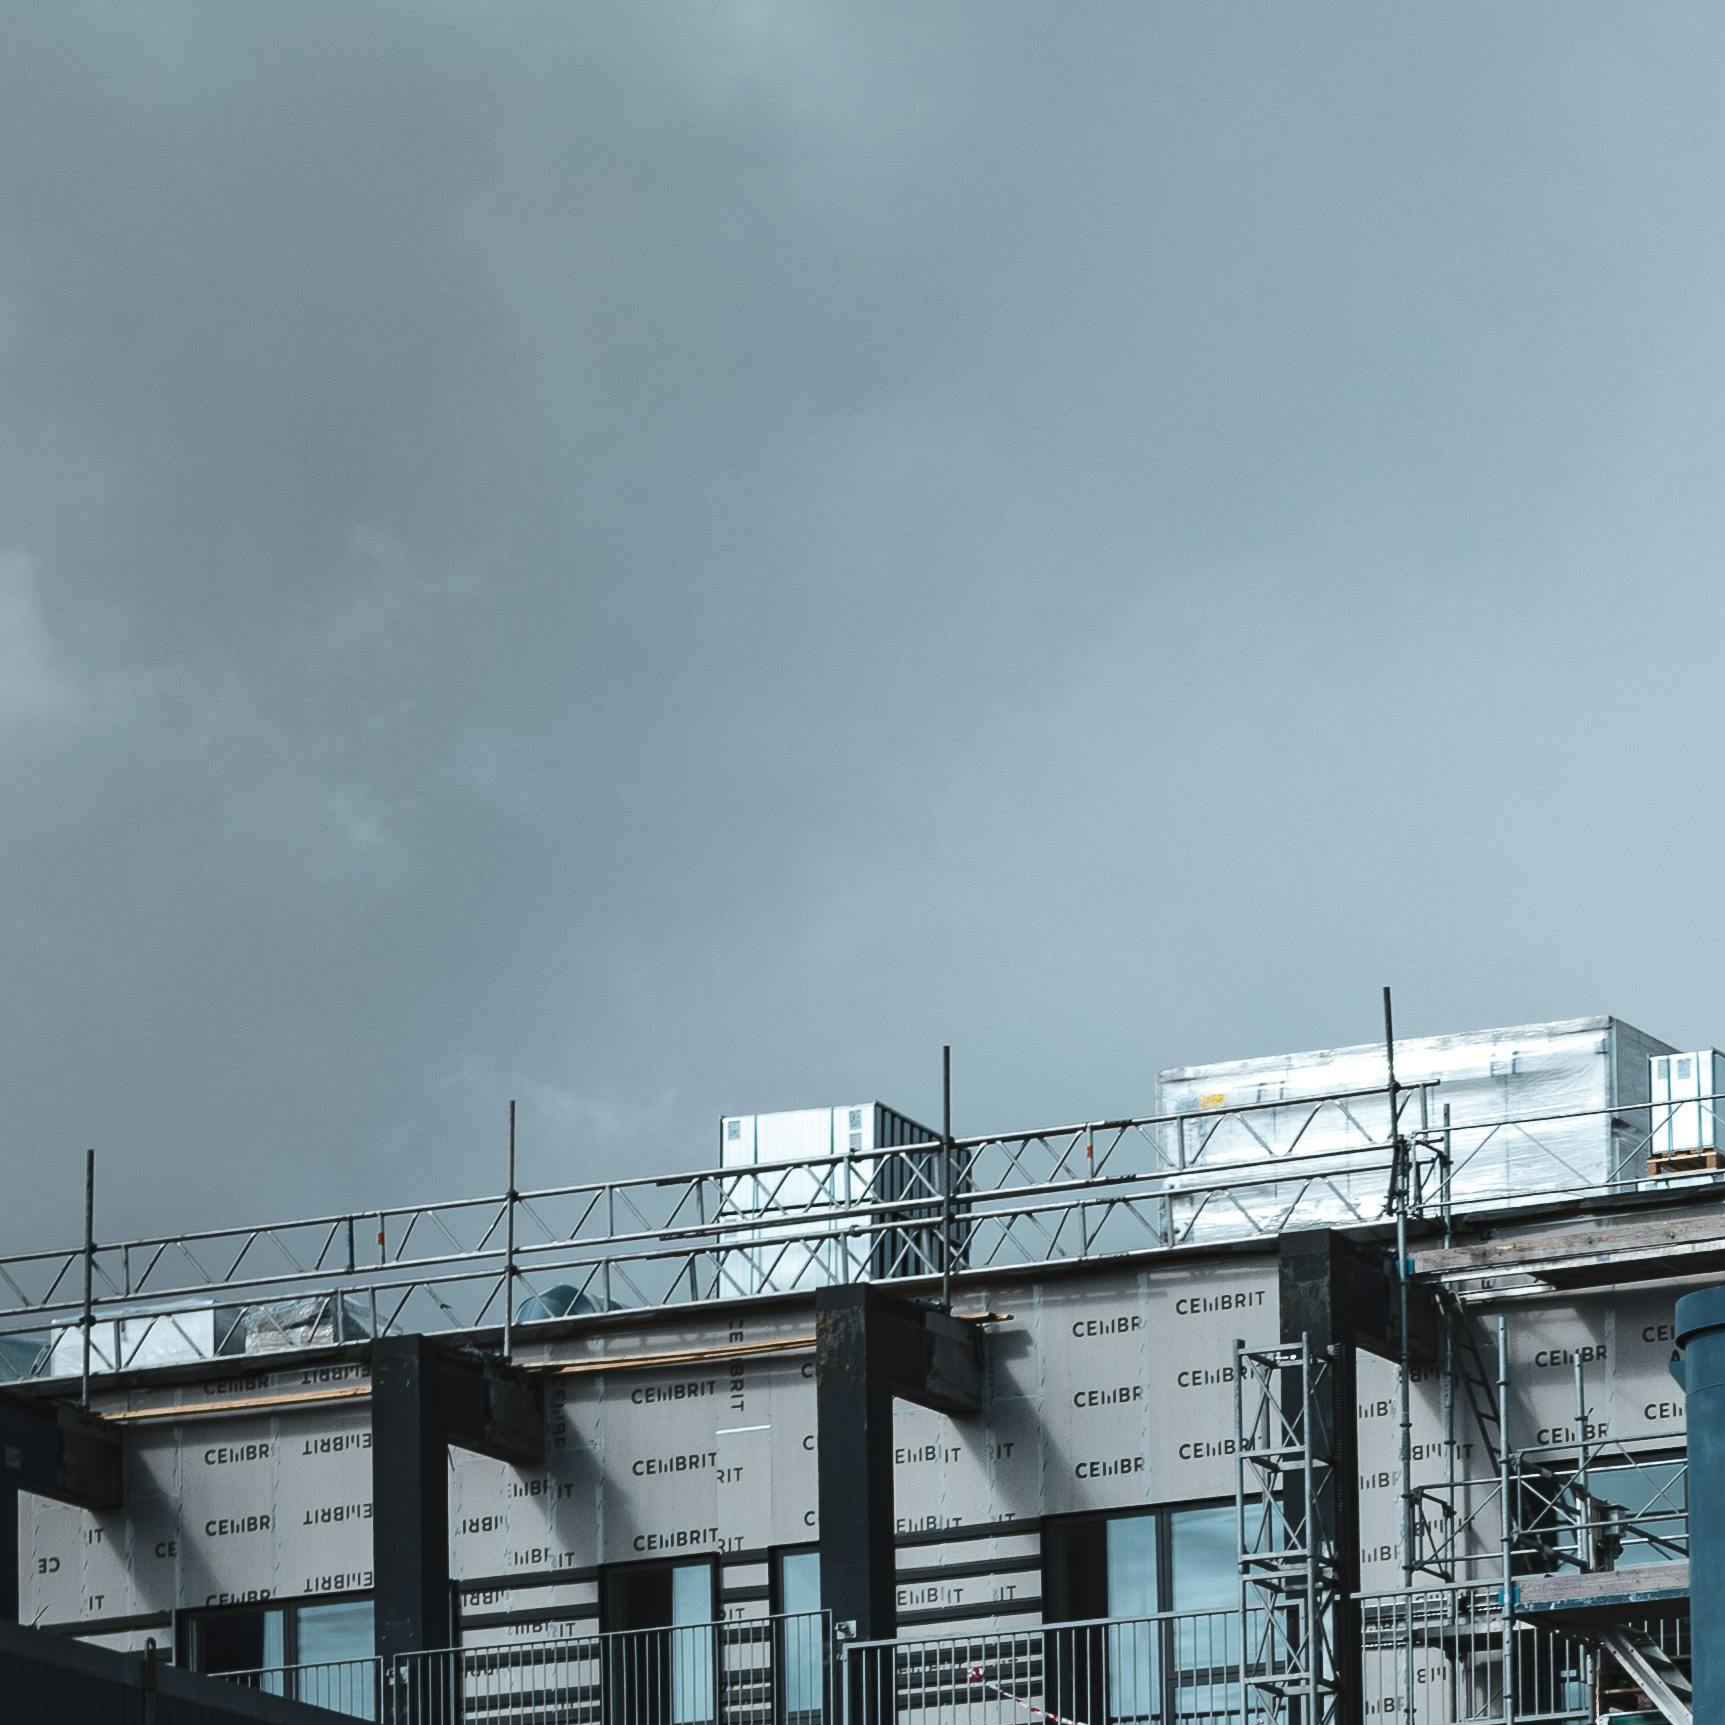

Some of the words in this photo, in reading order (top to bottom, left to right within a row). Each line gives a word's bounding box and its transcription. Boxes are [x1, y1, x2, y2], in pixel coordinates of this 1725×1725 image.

[1176, 1291, 1266, 1315] CEMBRIT
[631, 1380, 716, 1405] CEMBRIT
[632, 1452, 718, 1477] CEMBRIT
[634, 1528, 719, 1552] CEMBRIT
